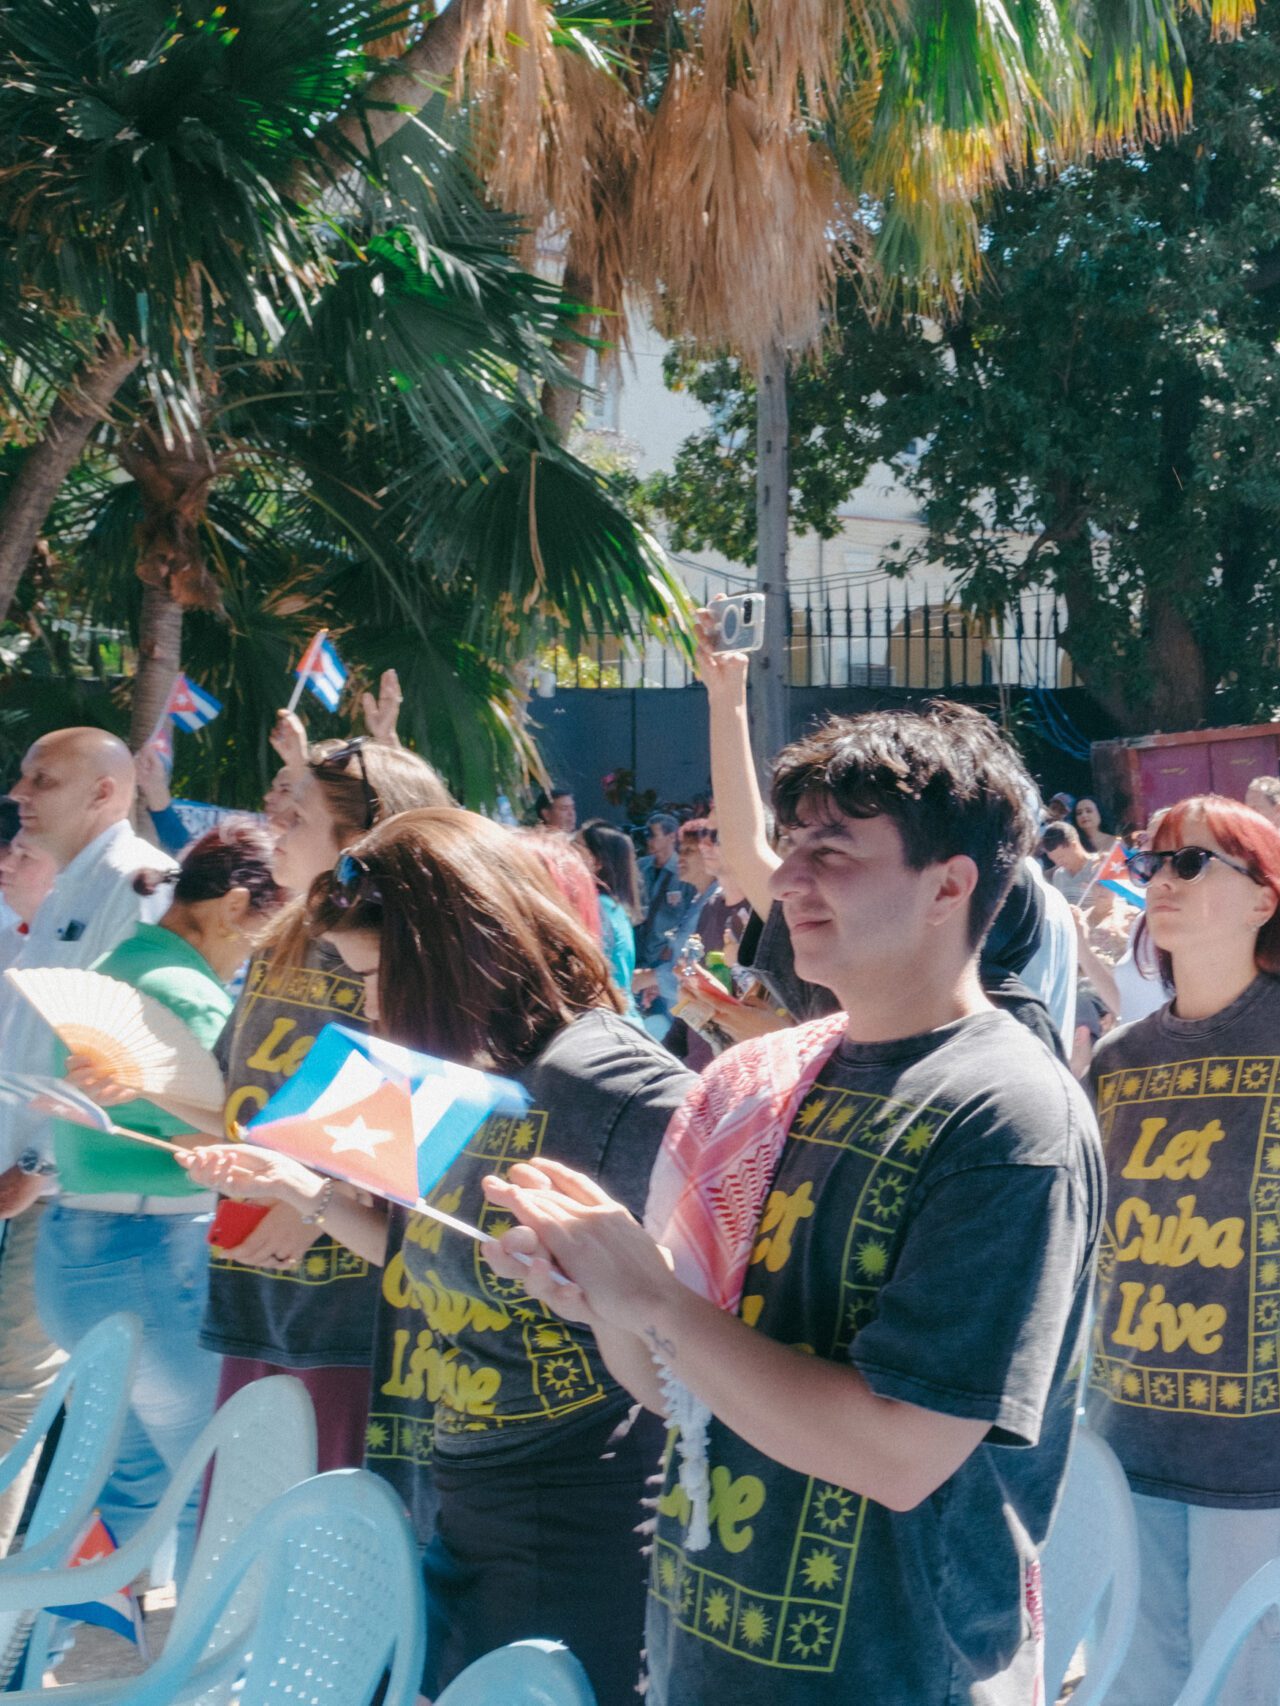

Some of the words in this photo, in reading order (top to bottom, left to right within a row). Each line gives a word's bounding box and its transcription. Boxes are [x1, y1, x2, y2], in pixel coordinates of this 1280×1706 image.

[246, 1017, 316, 1077] Le
[1121, 1117, 1226, 1181] Let
[749, 1181, 816, 1273] et
[1115, 1194, 1246, 1269] Cuba
[1111, 1281, 1228, 1355] Live
[380, 1329, 502, 1416] Live
